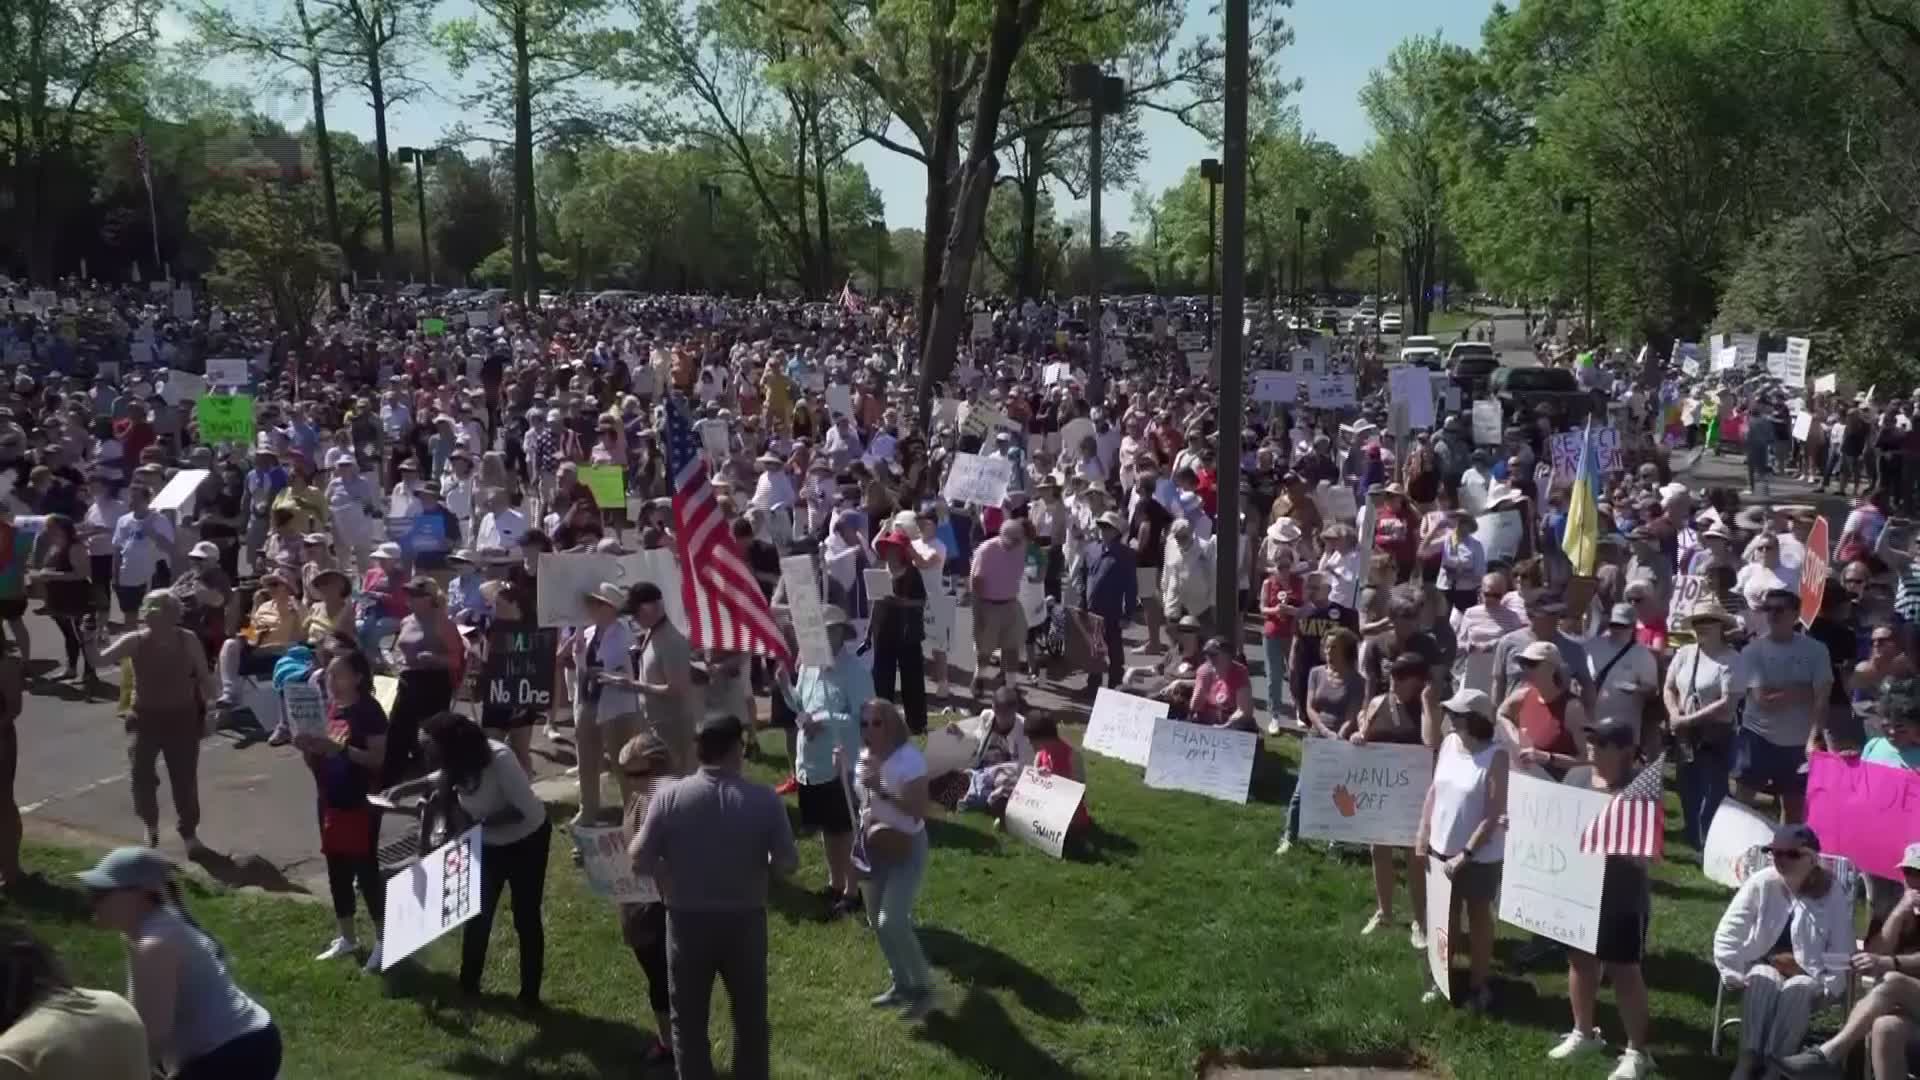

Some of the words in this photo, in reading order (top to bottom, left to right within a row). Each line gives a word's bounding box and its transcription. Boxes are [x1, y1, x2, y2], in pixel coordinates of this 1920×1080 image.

[490, 679, 511, 704] No
[518, 677, 550, 705] One
[1173, 727, 1233, 750] HANDS
[1345, 767, 1410, 788] HANDS
